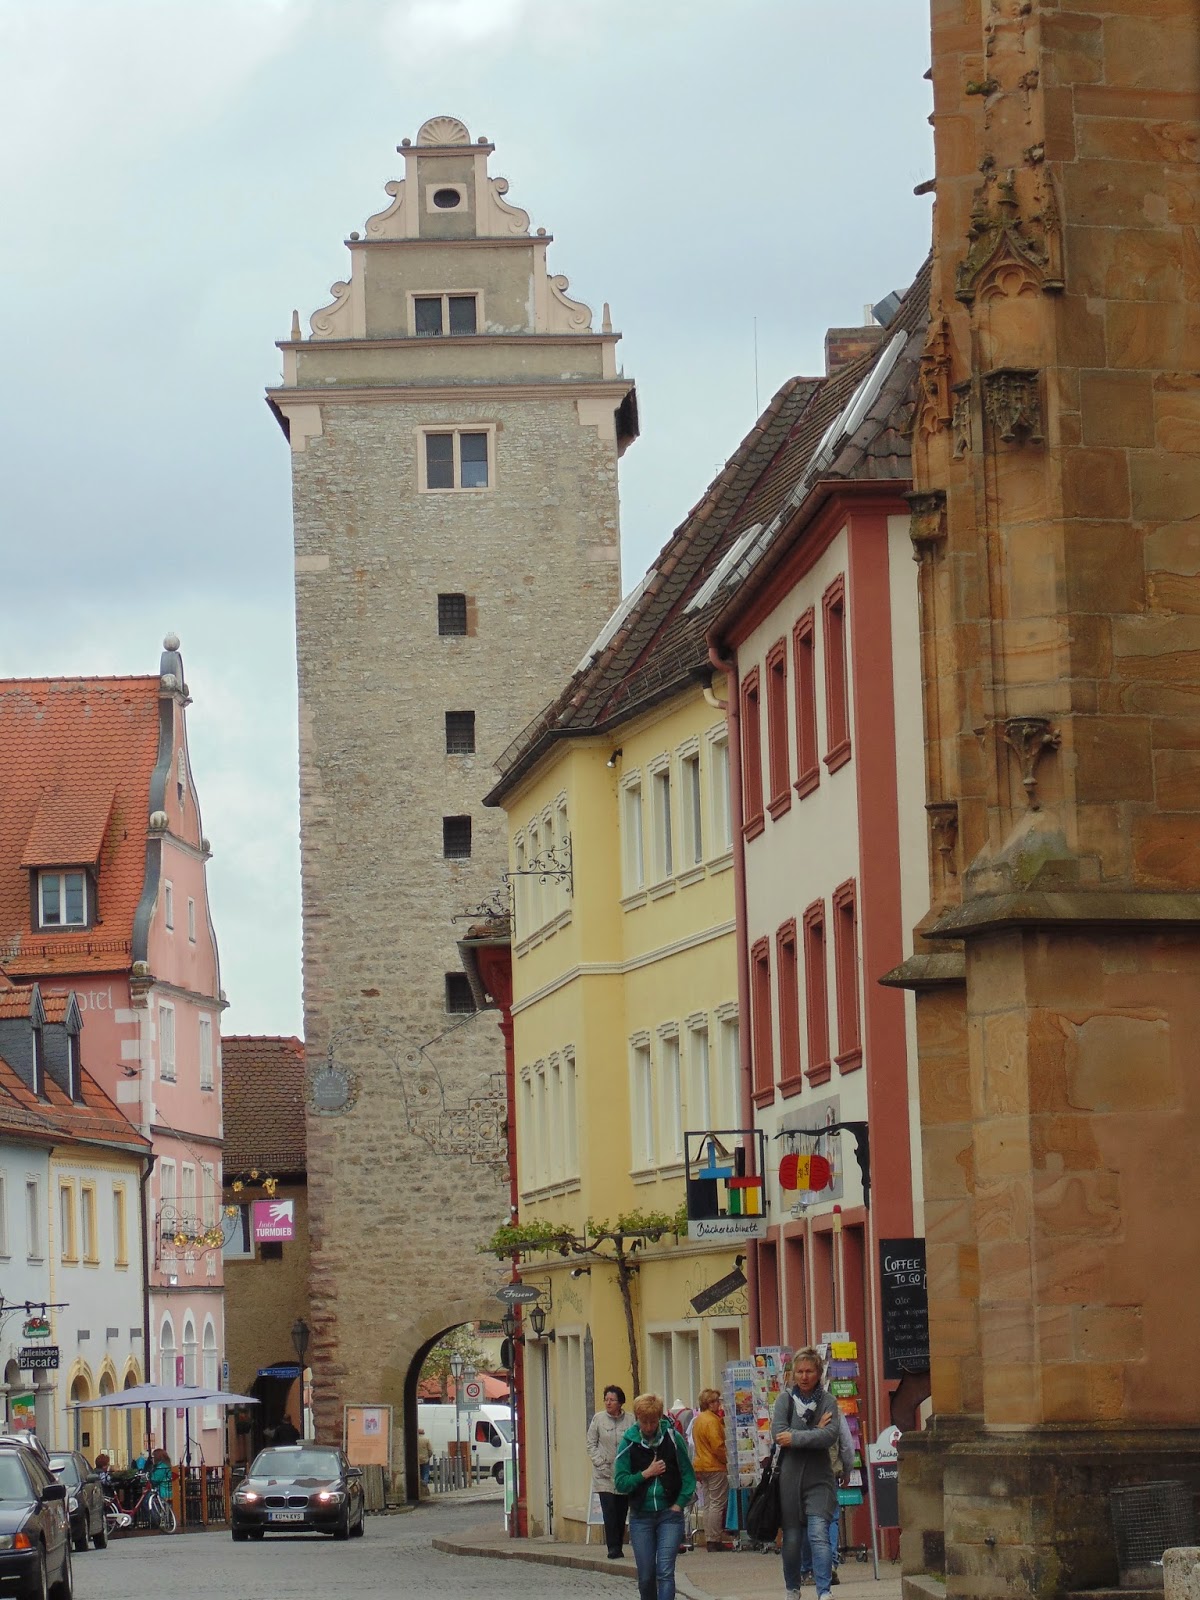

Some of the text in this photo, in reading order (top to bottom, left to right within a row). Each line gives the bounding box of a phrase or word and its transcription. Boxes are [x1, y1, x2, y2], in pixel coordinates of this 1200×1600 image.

[256, 1227, 292, 1237] TURMDIEB
[697, 1222, 758, 1237] Bücherkabinett
[894, 1273, 921, 1284] TO GO
[20, 1356, 58, 1368] Eiscafe
